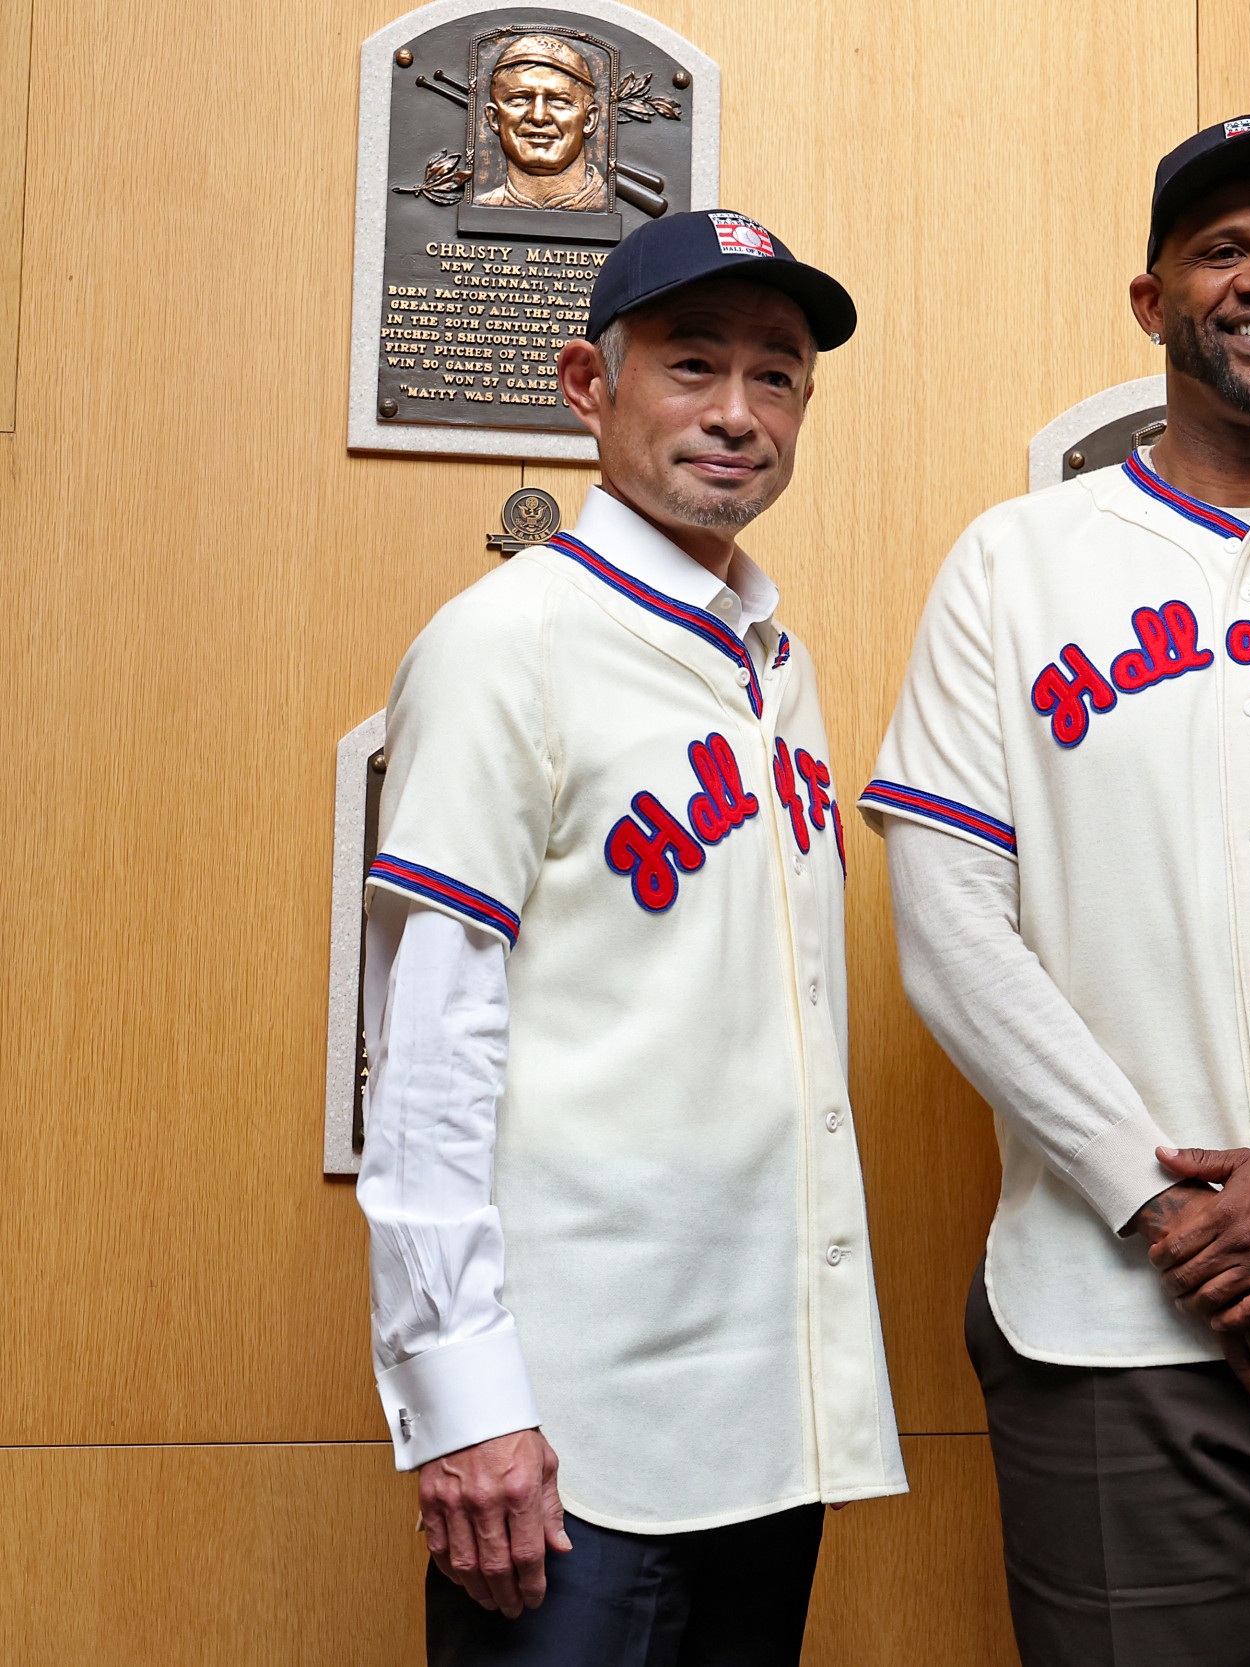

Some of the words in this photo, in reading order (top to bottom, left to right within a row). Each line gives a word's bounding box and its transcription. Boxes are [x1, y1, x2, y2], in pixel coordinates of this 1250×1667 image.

[426, 242, 512, 260] CHRISTY
[441, 261, 474, 272] NEW
[454, 275, 549, 292] CINCINNATI,
[388, 285, 427, 297] BORN
[435, 289, 545, 305] FACTORYVILLE,
[390, 300, 463, 312] GREATEST
[468, 306, 485, 315] OF
[489, 306, 519, 317] ALL
[524, 308, 551, 318] THE
[387, 314, 403, 324] IN
[411, 316, 438, 326] THE
[445, 318, 480, 329] 20TH
[485, 320, 560, 333] CENTURY'S
[381, 328, 440, 340] PITCHED
[445, 332, 453, 341] 3
[457, 333, 527, 345] SHUTOUTS
[532, 337, 546, 347] IN
[385, 342, 427, 353] FIRST
[434, 346, 492, 358] PITCHER
[499, 349, 516, 359] OF
[521, 351, 548, 361] THE
[387, 357, 415, 367] WIN
[422, 360, 439, 369] 30
[445, 361, 493, 372] GAMES
[499, 363, 515, 373] IN
[521, 365, 529, 374] 3
[537, 366, 558, 375] SU
[443, 375, 475, 385] WON
[483, 377, 499, 386] 37
[506, 378, 558, 389] GAMES
[400, 384, 457, 399] "MATTY
[464, 391, 493, 401] WAS
[500, 393, 556, 405] MASTER
[1032, 600, 1214, 748] Hall
[604, 732, 759, 913] Hall
